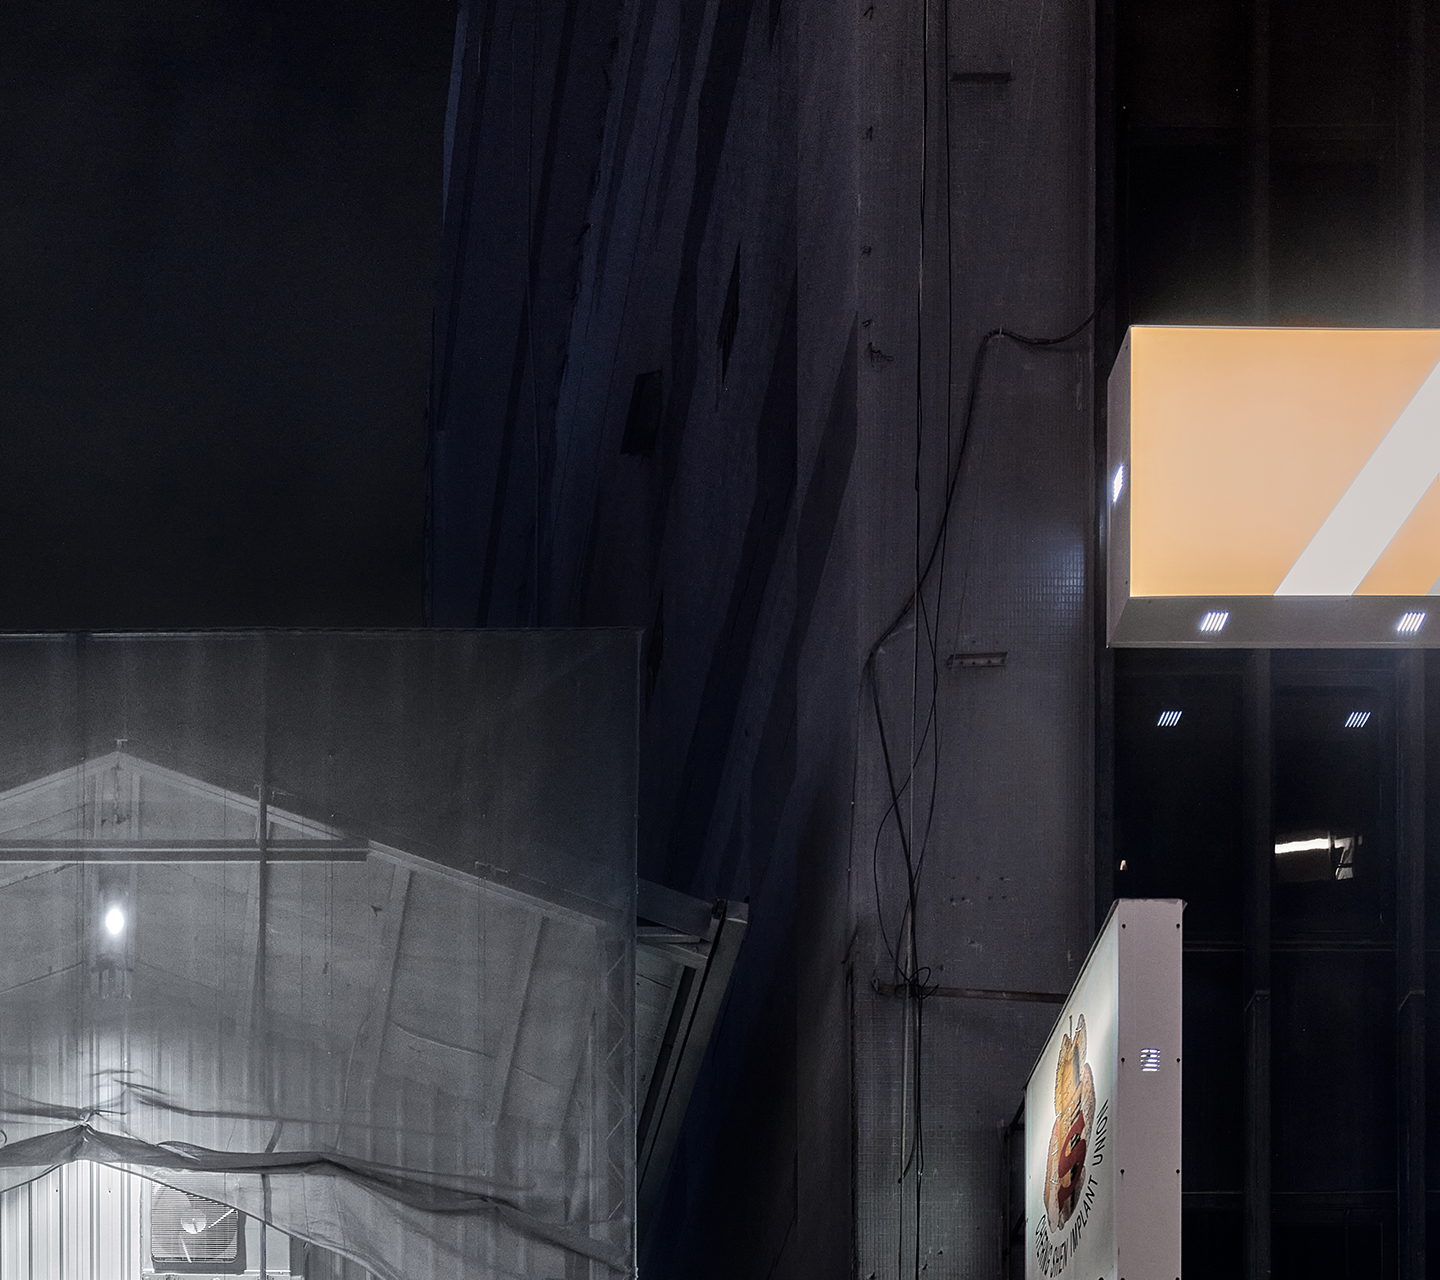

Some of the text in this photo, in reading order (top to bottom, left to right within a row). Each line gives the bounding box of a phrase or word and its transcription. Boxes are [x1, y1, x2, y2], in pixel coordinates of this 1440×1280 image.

[1035, 1213, 1051, 1278] CHERNG
[1068, 1174, 1099, 1267] IMPLANT
[1092, 1098, 1109, 1167] UNION
